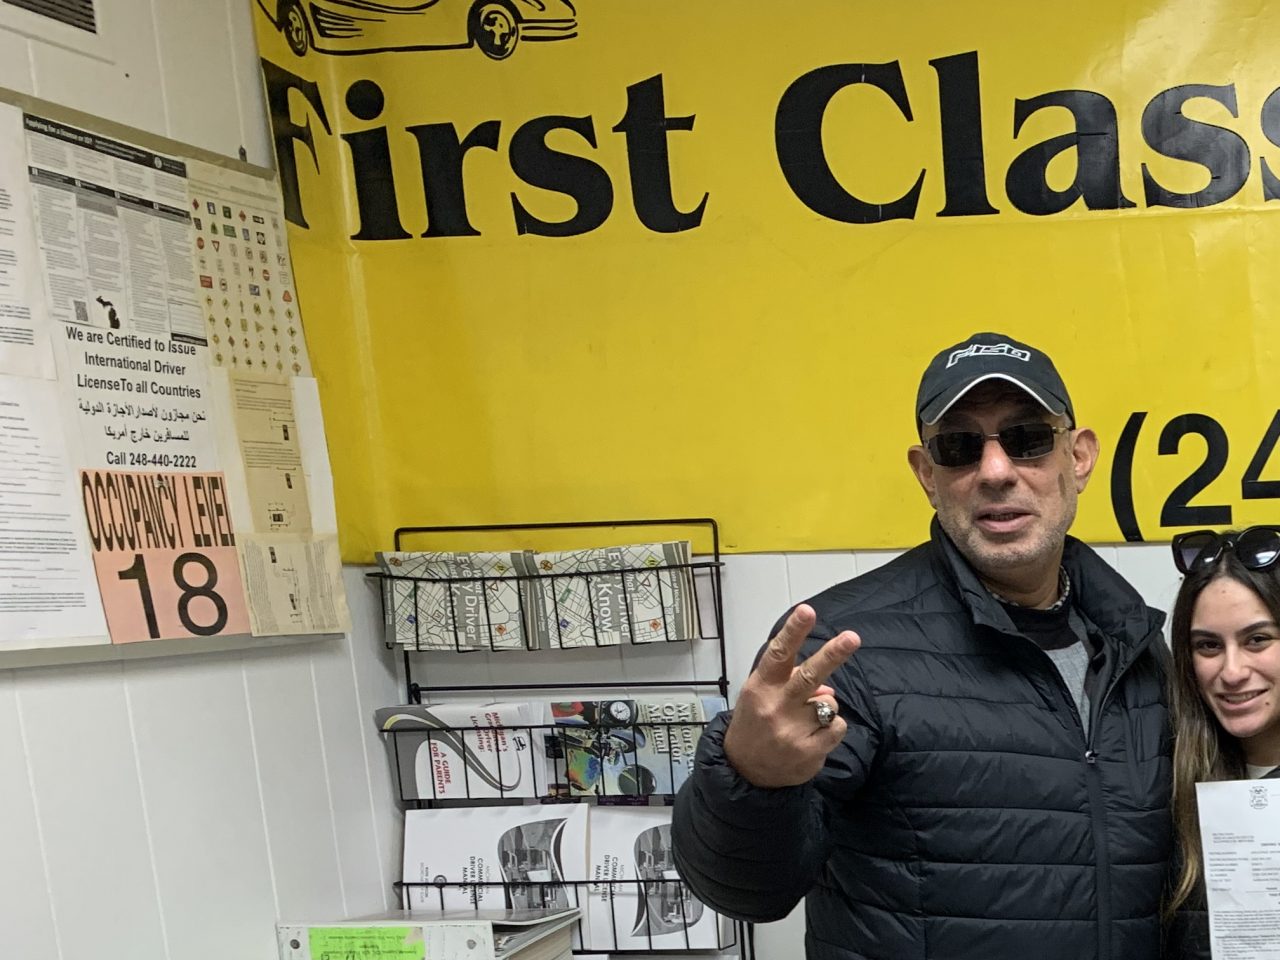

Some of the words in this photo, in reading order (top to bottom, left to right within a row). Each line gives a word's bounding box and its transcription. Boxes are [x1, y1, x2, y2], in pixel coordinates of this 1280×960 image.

[262, 56, 709, 240] First
[66, 326, 84, 341] We
[86, 330, 104, 344] are
[106, 330, 152, 350] Certified
[154, 337, 166, 351] to
[168, 340, 196, 356] Issue
[84, 351, 152, 373] International
[154, 357, 187, 376] Driver
[136, 377, 148, 394] all
[150, 381, 201, 399] Countries
[106, 451, 127, 466] Call
[129, 452, 197, 469] 248-440-2222
[81, 471, 184, 552] OCCUPANCY
[182, 475, 236, 548] LEVEL
[118, 551, 229, 639] 18
[456, 556, 474, 592] Evey
[465, 596, 478, 640] Driver
[472, 569, 482, 594] Wat
[608, 552, 623, 590] Evry
[618, 594, 632, 638] Driver
[597, 583, 613, 632] Know
[661, 703, 682, 764] Oprator
[434, 760, 445, 794] PARENTS
[441, 760, 451, 784] GUIDE
